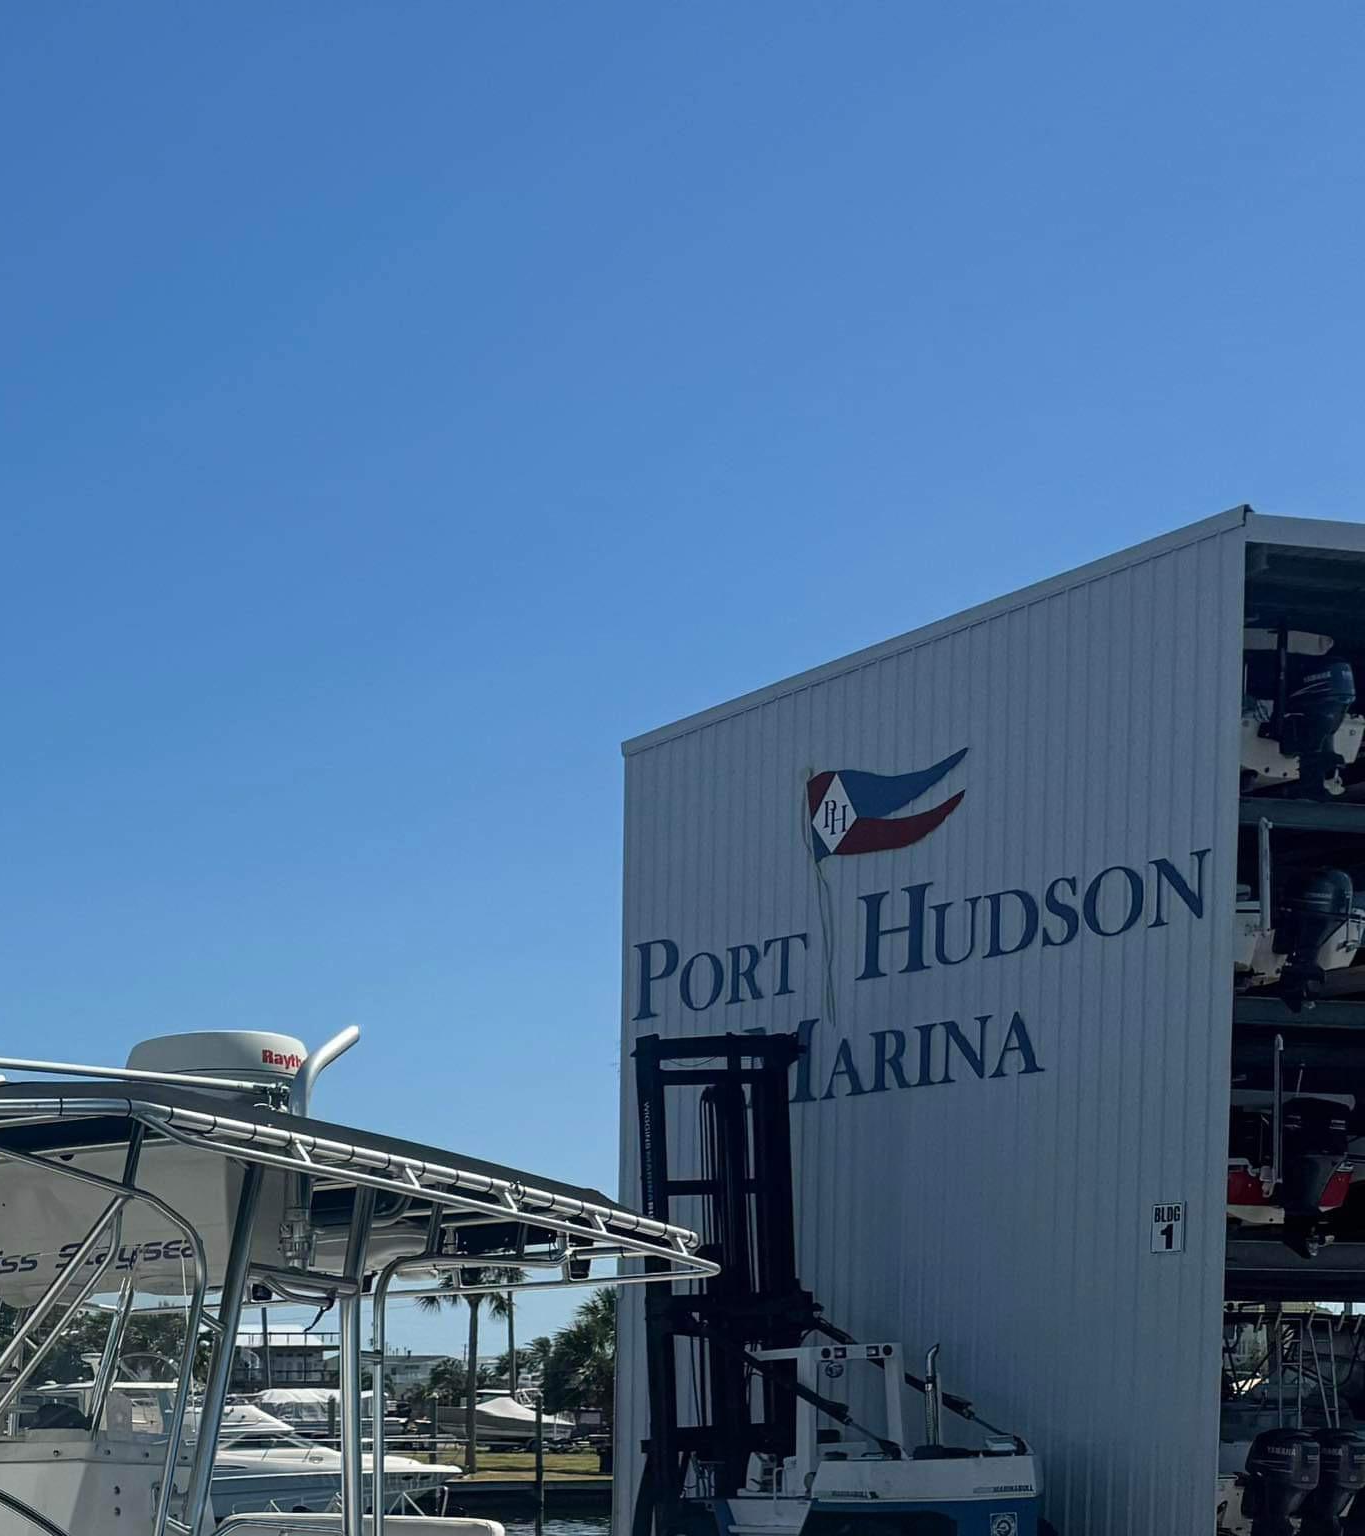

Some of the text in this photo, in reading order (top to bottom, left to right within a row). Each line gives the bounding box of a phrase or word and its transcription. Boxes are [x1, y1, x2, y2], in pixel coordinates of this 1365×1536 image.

[632, 848, 1212, 1021] PORT HUDSON
[1154, 1205, 1181, 1223] BLDG
[1160, 1223, 1174, 1250] 1
